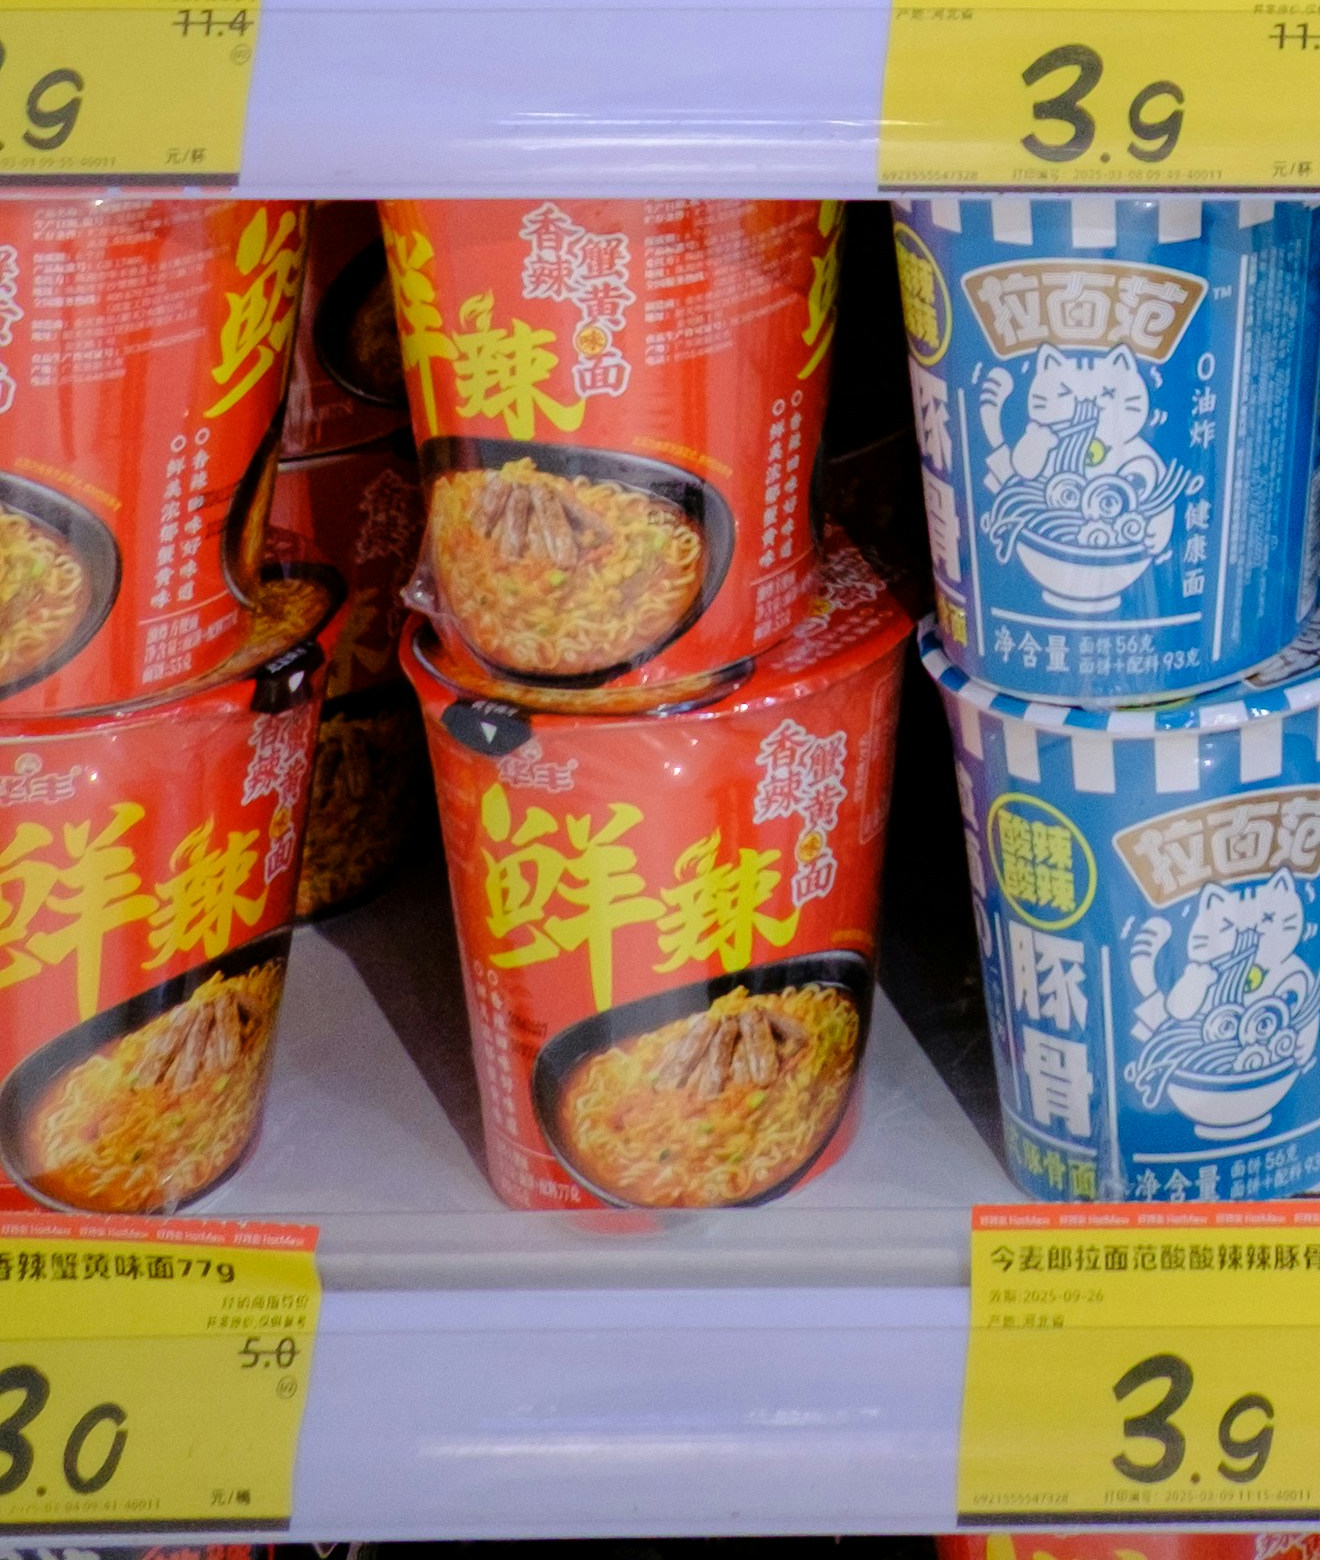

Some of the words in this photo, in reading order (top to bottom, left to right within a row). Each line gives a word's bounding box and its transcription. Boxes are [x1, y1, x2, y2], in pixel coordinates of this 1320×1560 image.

[172, 9, 254, 38] 11.4
[1020, 43, 1186, 164] 3.9
[238, 1336, 299, 1369] 5.0
[0, 1364, 128, 1496] 3.0
[1111, 1353, 1276, 1484] 3.9
